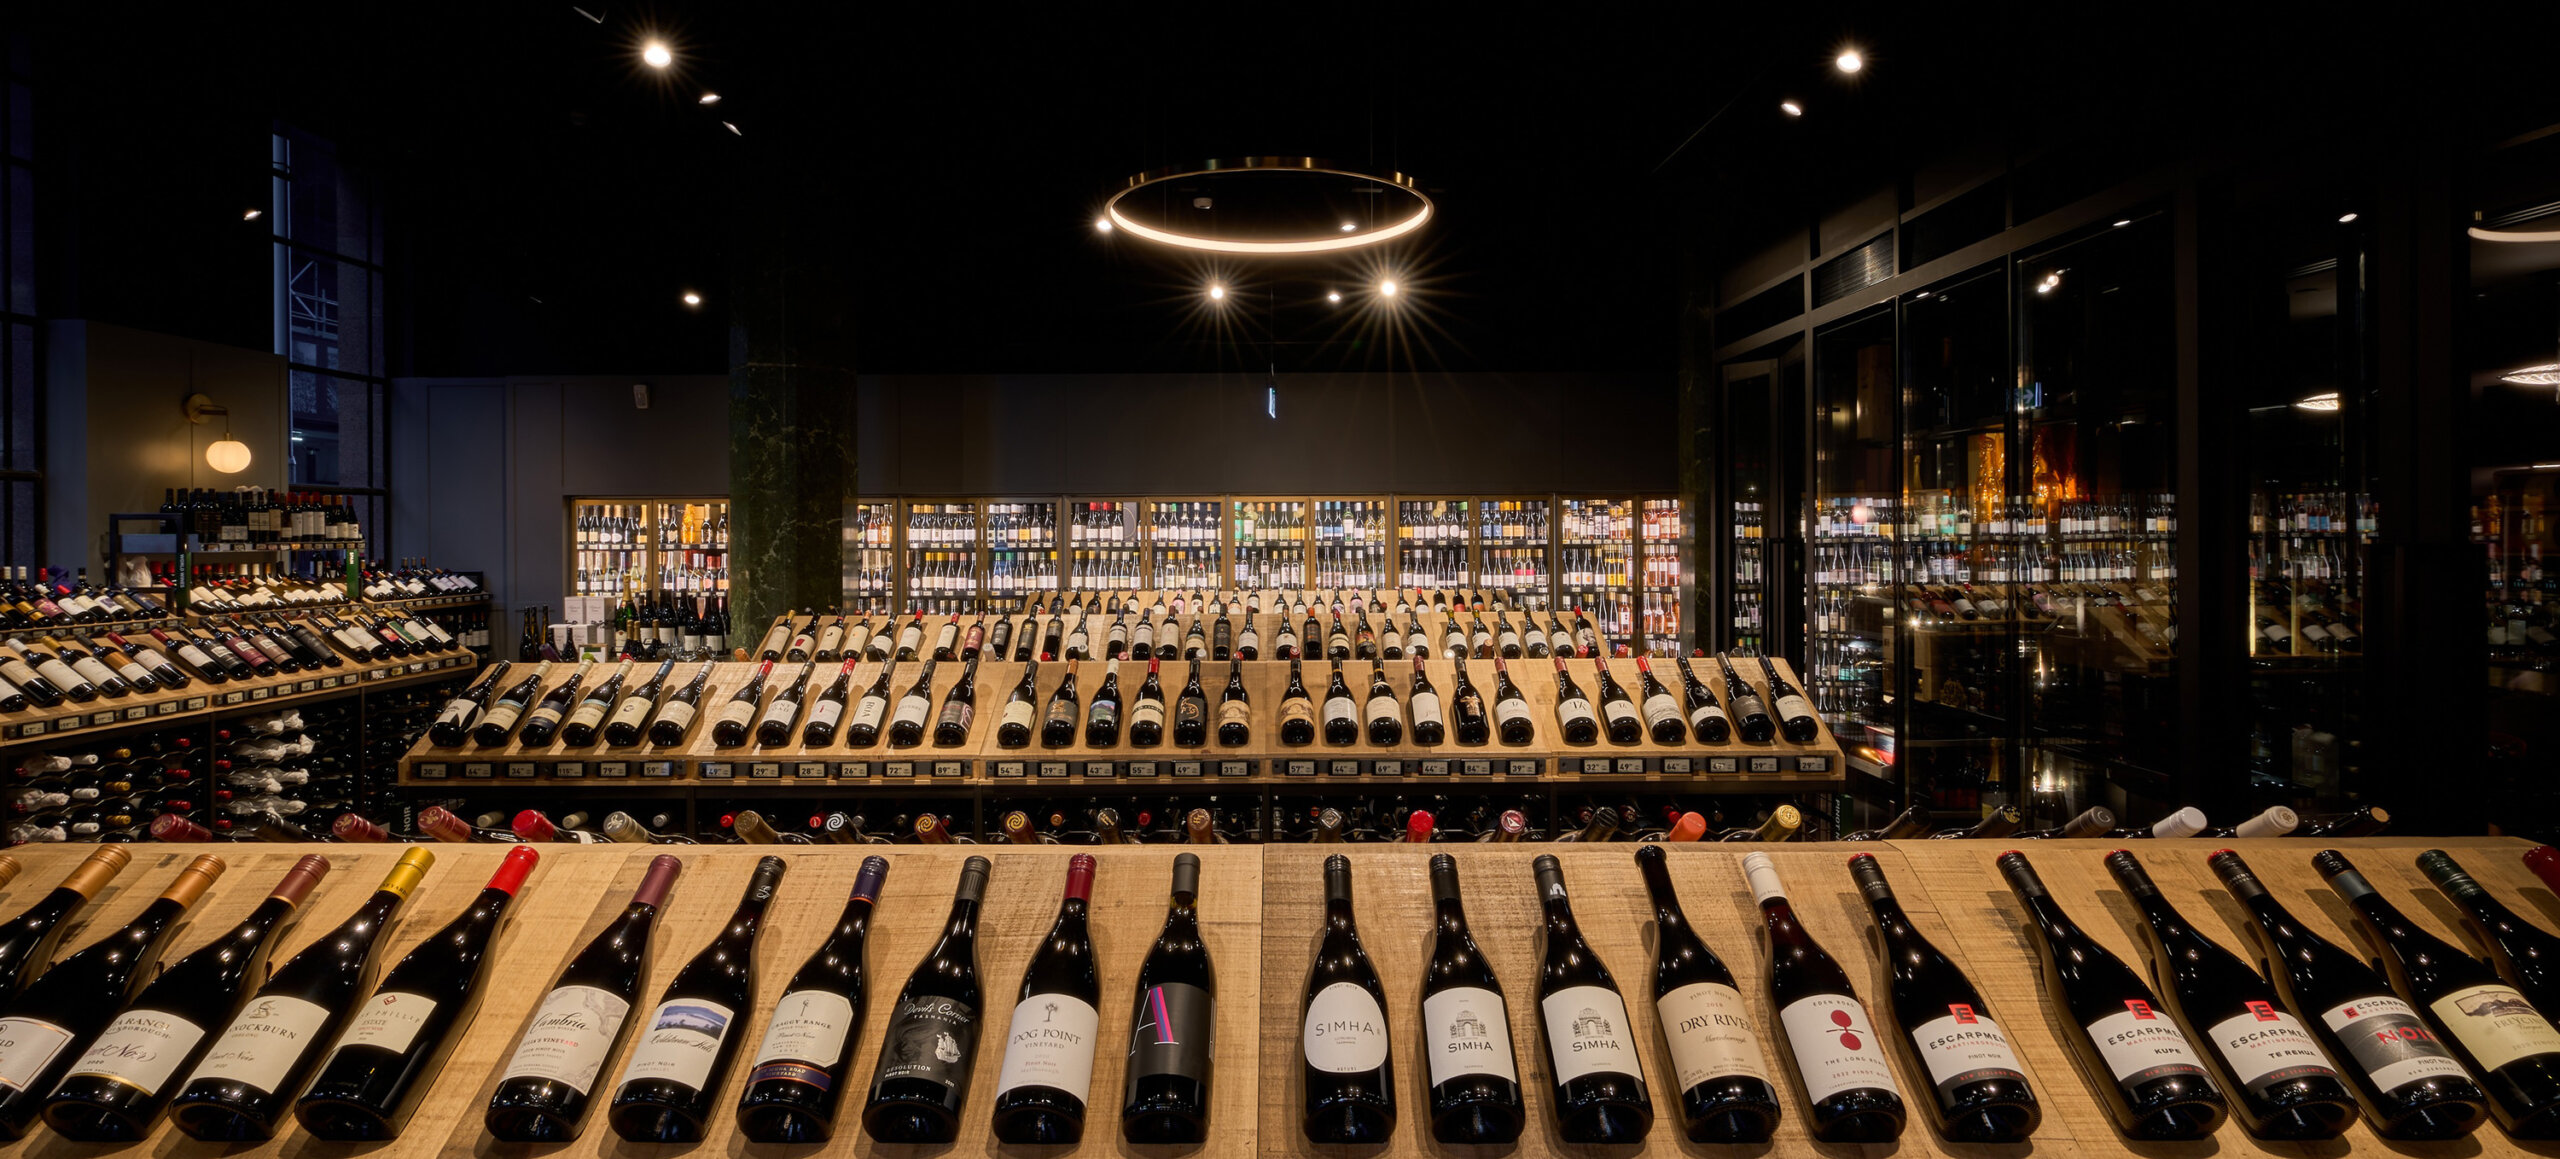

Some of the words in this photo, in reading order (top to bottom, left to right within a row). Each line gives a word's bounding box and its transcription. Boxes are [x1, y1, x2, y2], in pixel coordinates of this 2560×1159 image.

[403, 806, 411, 832] NOIR
[1689, 990, 1711, 1000] PINOT
[1714, 990, 1732, 1000] NOIR
[937, 1003, 970, 1023] Corner
[1954, 1007, 1973, 1021] E
[2131, 1003, 2152, 1016] E
[2253, 1004, 2274, 1018] E
[2346, 1008, 2356, 1017] E
[529, 1012, 590, 1035] Cambria
[803, 1019, 832, 1030] RANGE
[913, 1014, 957, 1026] TASMANIA
[1129, 986, 1179, 1056] A
[1680, 1014, 1710, 1034] DRY
[1315, 1021, 1375, 1037] SIMHA
[543, 1037, 579, 1048] VINEYARD
[1013, 1029, 1039, 1045] DOG
[1043, 1028, 1081, 1045] POINT
[1929, 1031, 2006, 1050] ESCARPMEN
[690, 1040, 717, 1053] Hills
[1024, 1041, 1065, 1049] VINEYARD
[1448, 1041, 1493, 1053] SIMHA
[1572, 1039, 1620, 1052] SIMHA
[2268, 1051, 2282, 1059] TE
[2284, 1049, 2316, 1057] REHUA
[1825, 1058, 1840, 1066] THE
[789, 1066, 806, 1074] ROAD
[886, 1064, 932, 1073] RESOLUTION
[2144, 1069, 2159, 1077] NEW
[1960, 1073, 1974, 1081] NEW
[2270, 1071, 2285, 1080] NEW
